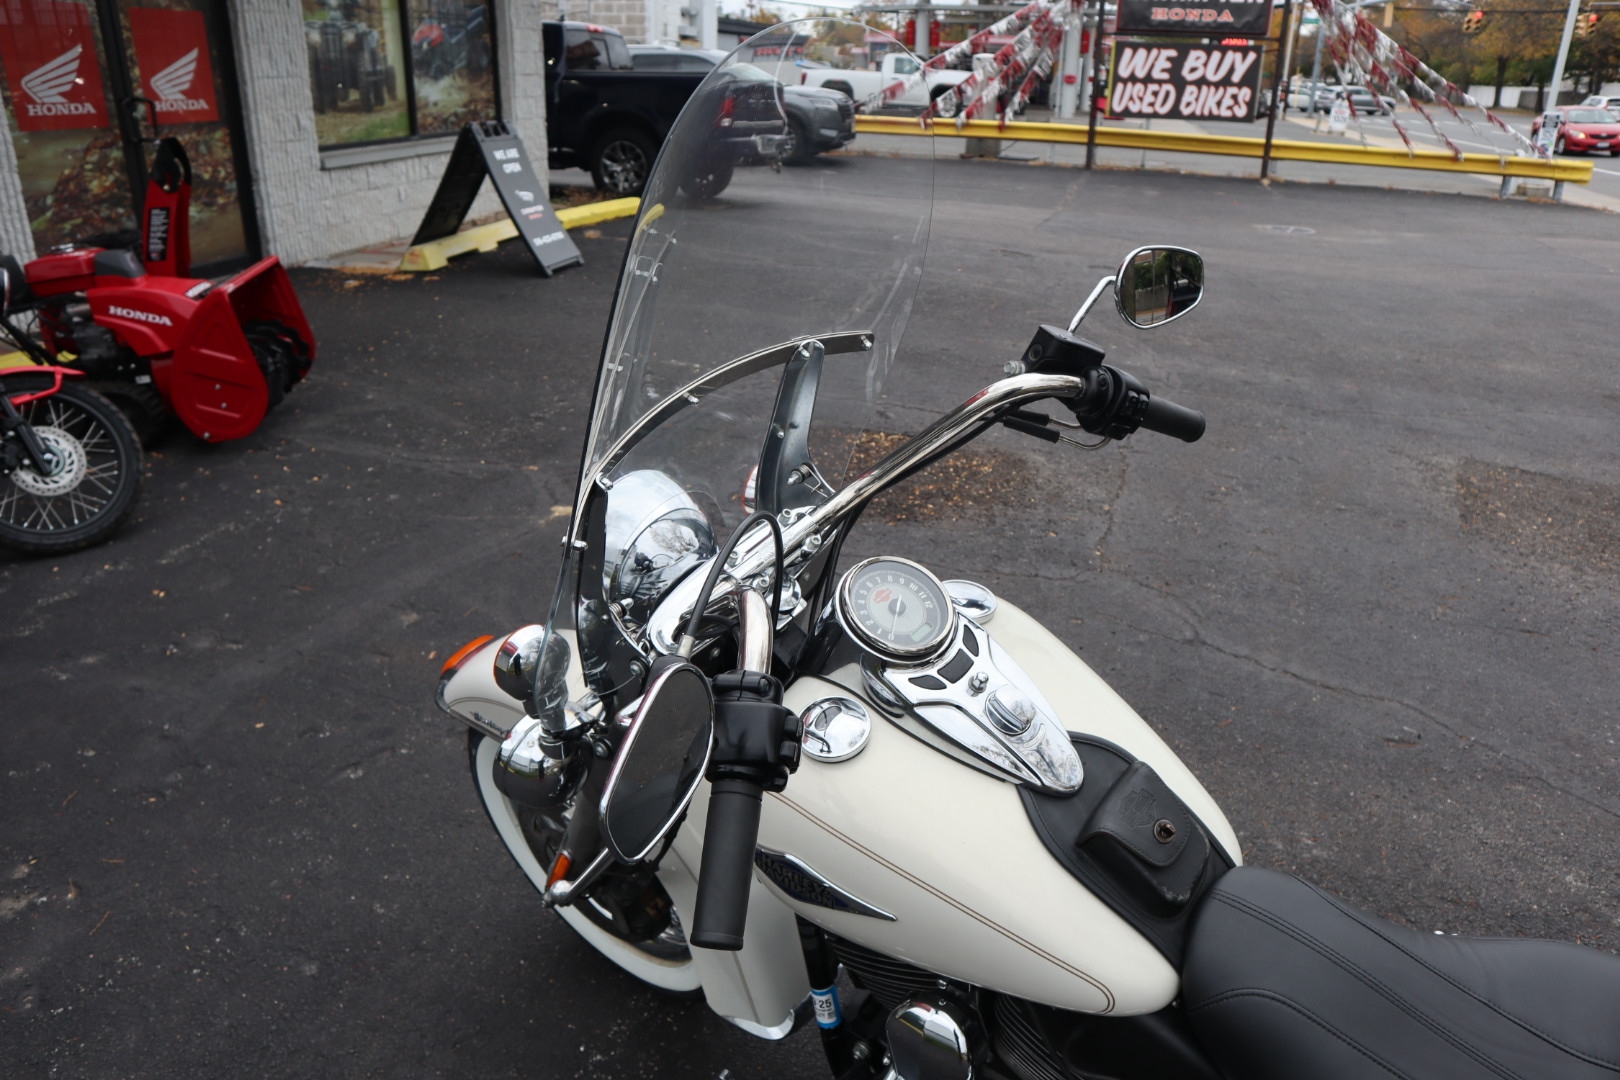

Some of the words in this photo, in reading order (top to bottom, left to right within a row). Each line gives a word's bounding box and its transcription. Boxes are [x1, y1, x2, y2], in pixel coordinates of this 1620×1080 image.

[1151, 7, 1234, 22] HONDA
[1117, 47, 1178, 79] WE
[1181, 50, 1257, 83] BUY
[155, 99, 210, 112] HONDA
[1111, 81, 1177, 115] USED
[1179, 84, 1252, 119] BIKES
[26, 102, 97, 117] HONDA
[108, 305, 174, 327] HONDA
